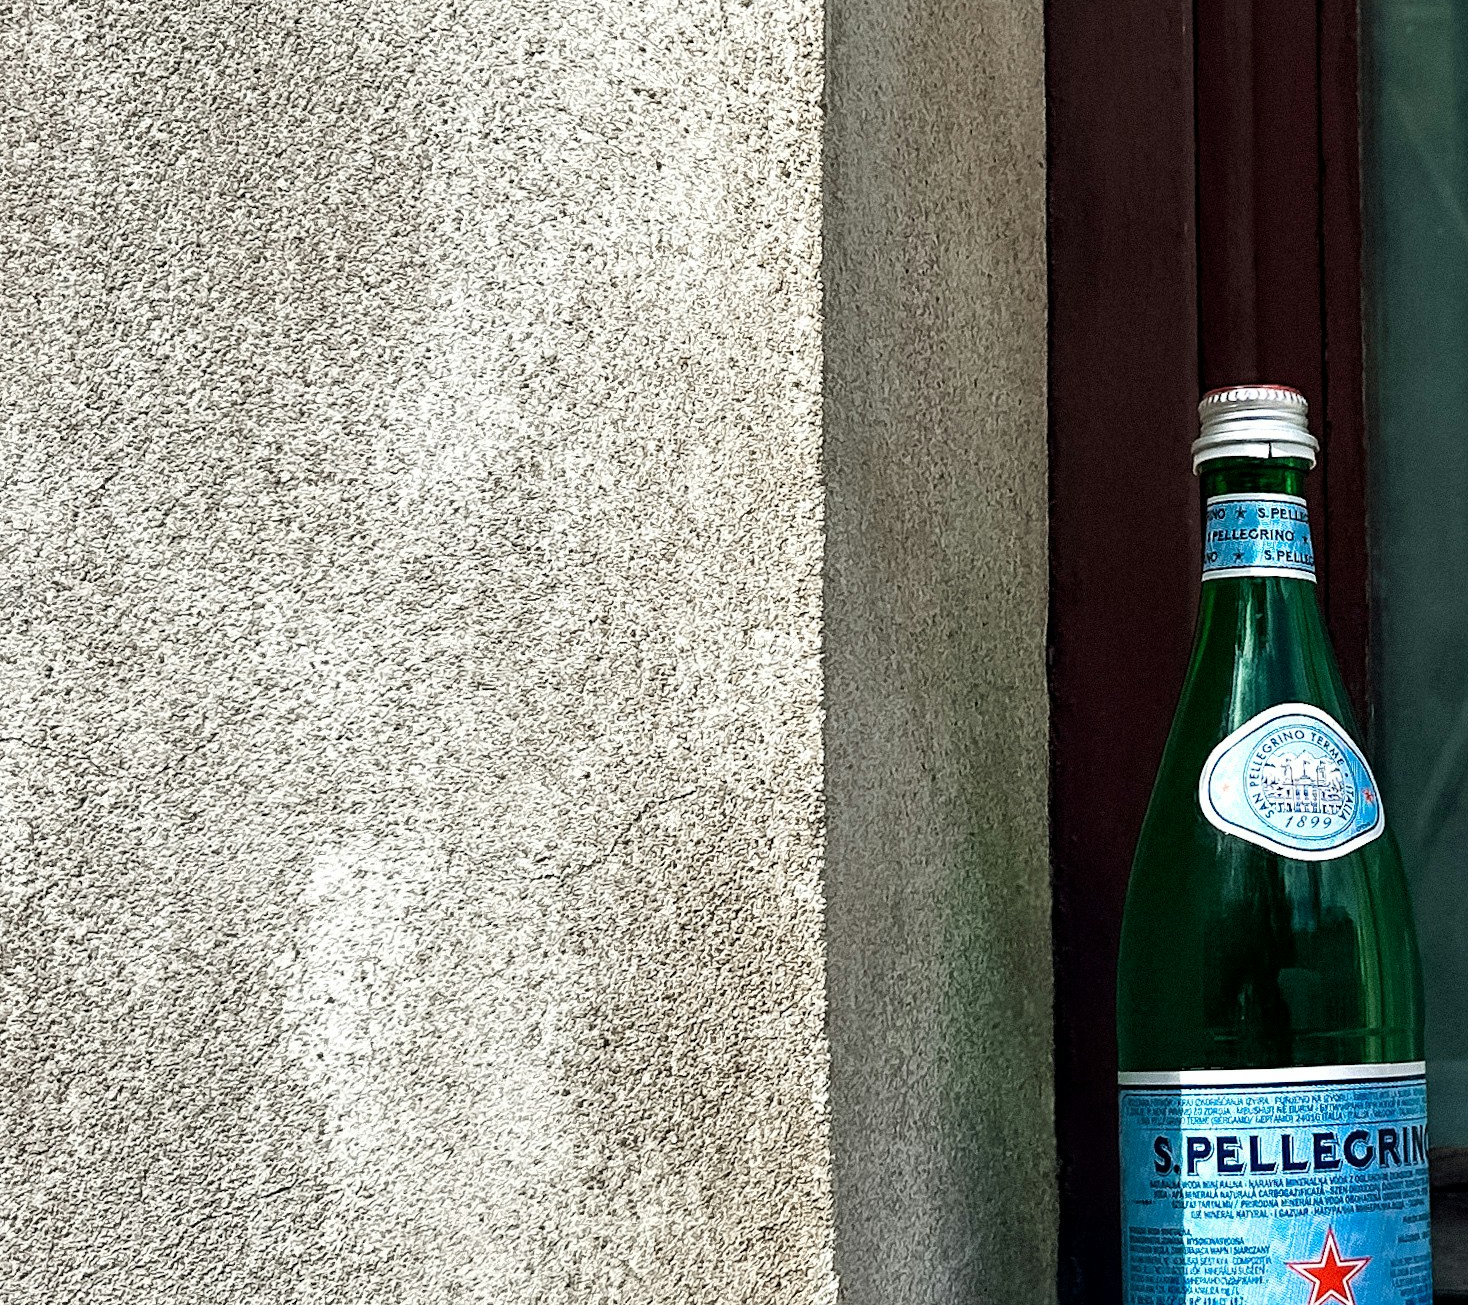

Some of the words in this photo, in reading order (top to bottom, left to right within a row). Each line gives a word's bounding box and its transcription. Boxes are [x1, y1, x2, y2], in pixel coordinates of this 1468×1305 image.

[1249, 730, 1305, 787] PELLEGRINO
[1310, 731, 1345, 766] TERME
[1252, 793, 1275, 819] SAN
[1284, 815, 1333, 829] 1899
[1153, 1124, 1430, 1176] S.PELLEGRIN
